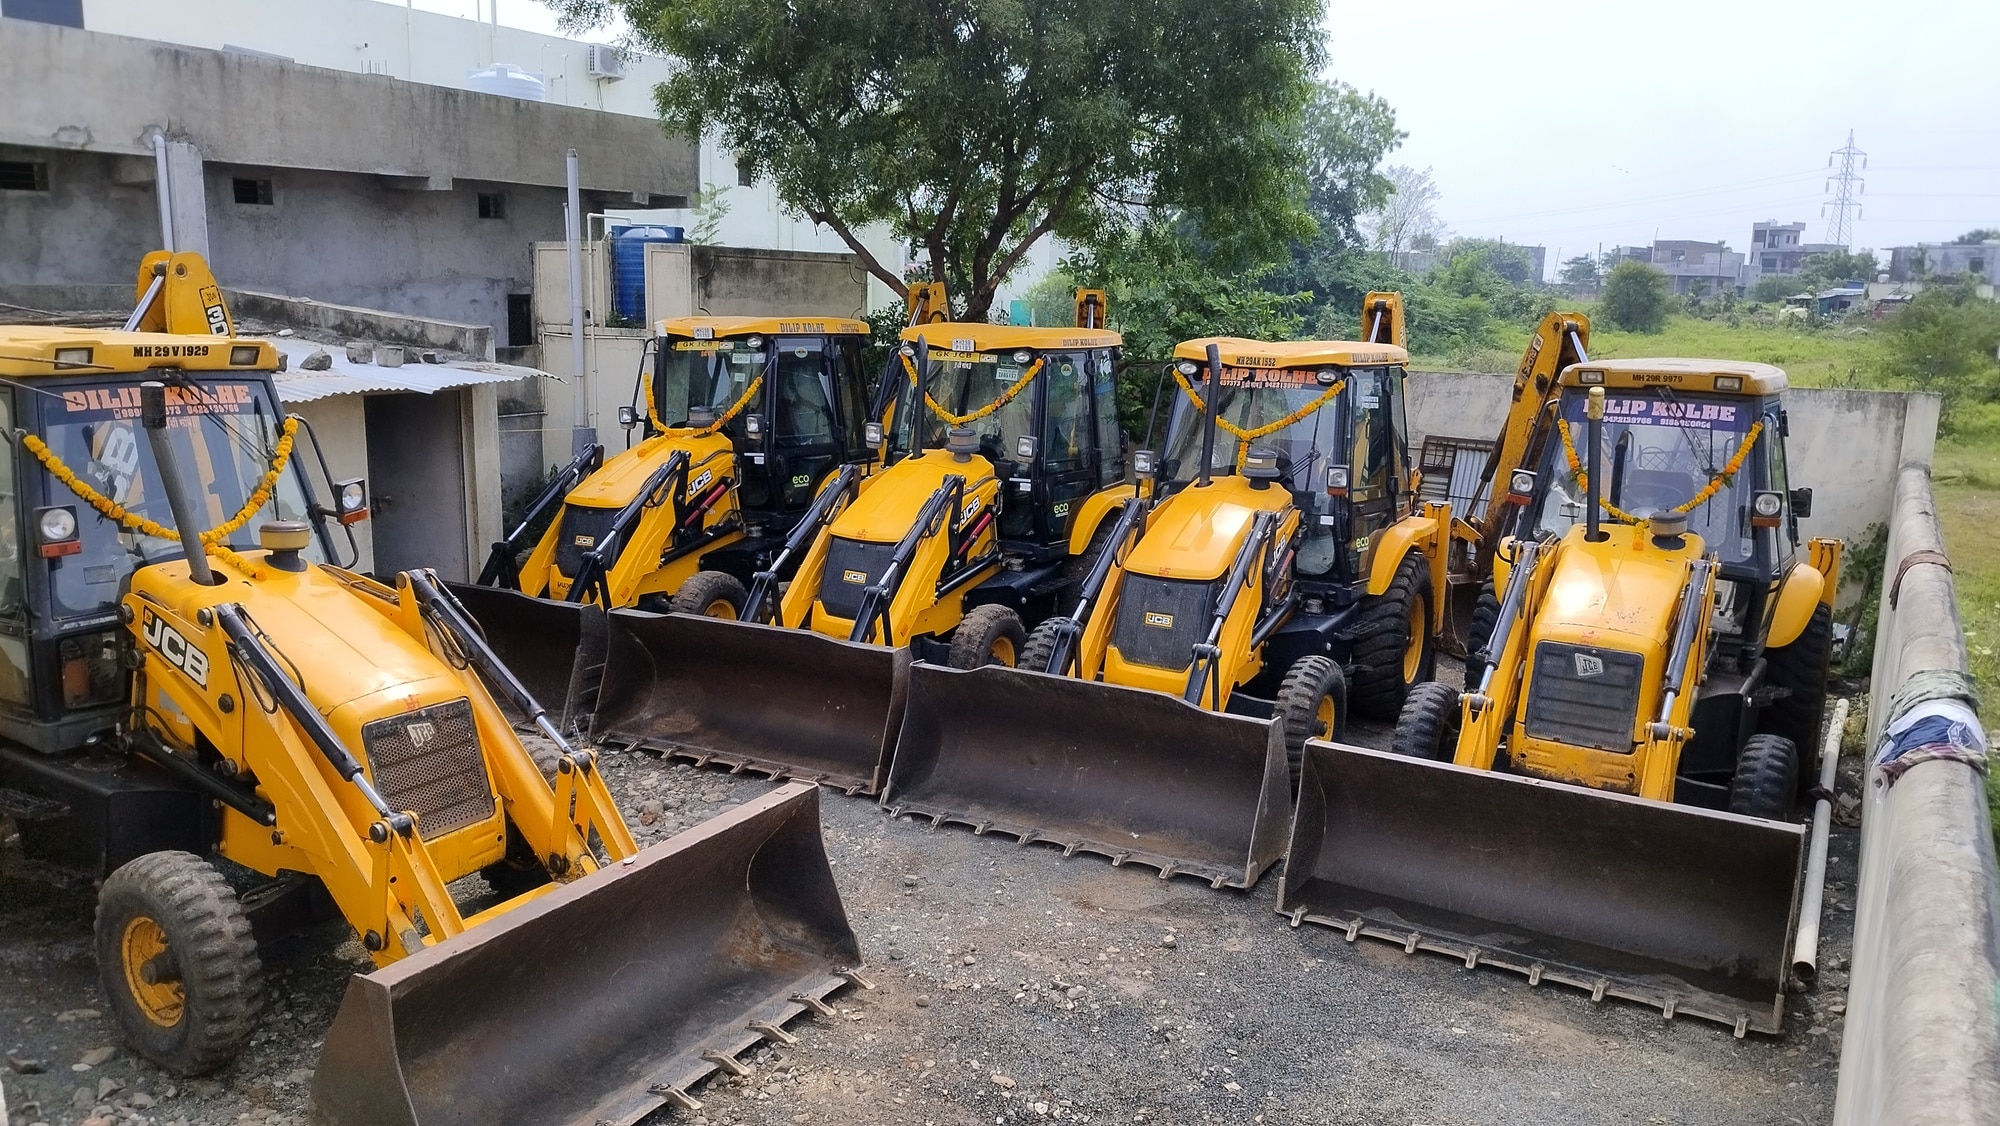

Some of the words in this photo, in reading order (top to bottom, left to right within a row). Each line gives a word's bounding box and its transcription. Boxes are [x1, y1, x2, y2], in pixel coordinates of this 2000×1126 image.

[780, 322, 800, 332] DILIP
[802, 322, 825, 332] KOLHE
[133, 346, 152, 357] MH
[154, 346, 170, 357] 29
[172, 346, 180, 357] V
[182, 346, 209, 356] 1929
[1236, 356, 1246, 365] MH
[1262, 357, 1277, 367] 1552
[1202, 367, 1249, 382] DLIP
[1254, 368, 1318, 385] KOLHE
[1646, 374, 1661, 382] 29R
[1663, 375, 1683, 383] 9979
[63, 387, 142, 412] DILI
[164, 385, 252, 406] KOLHE
[1651, 401, 1737, 422] KOLHE
[689, 469, 712, 496] JCB
[792, 474, 810, 484] eco
[960, 496, 980, 525] JCB
[1053, 503, 1069, 514] eco
[1355, 536, 1370, 548] eco
[846, 572, 864, 581] JCB
[1148, 614, 1171, 625] JCB
[143, 617, 209, 686] JCB
